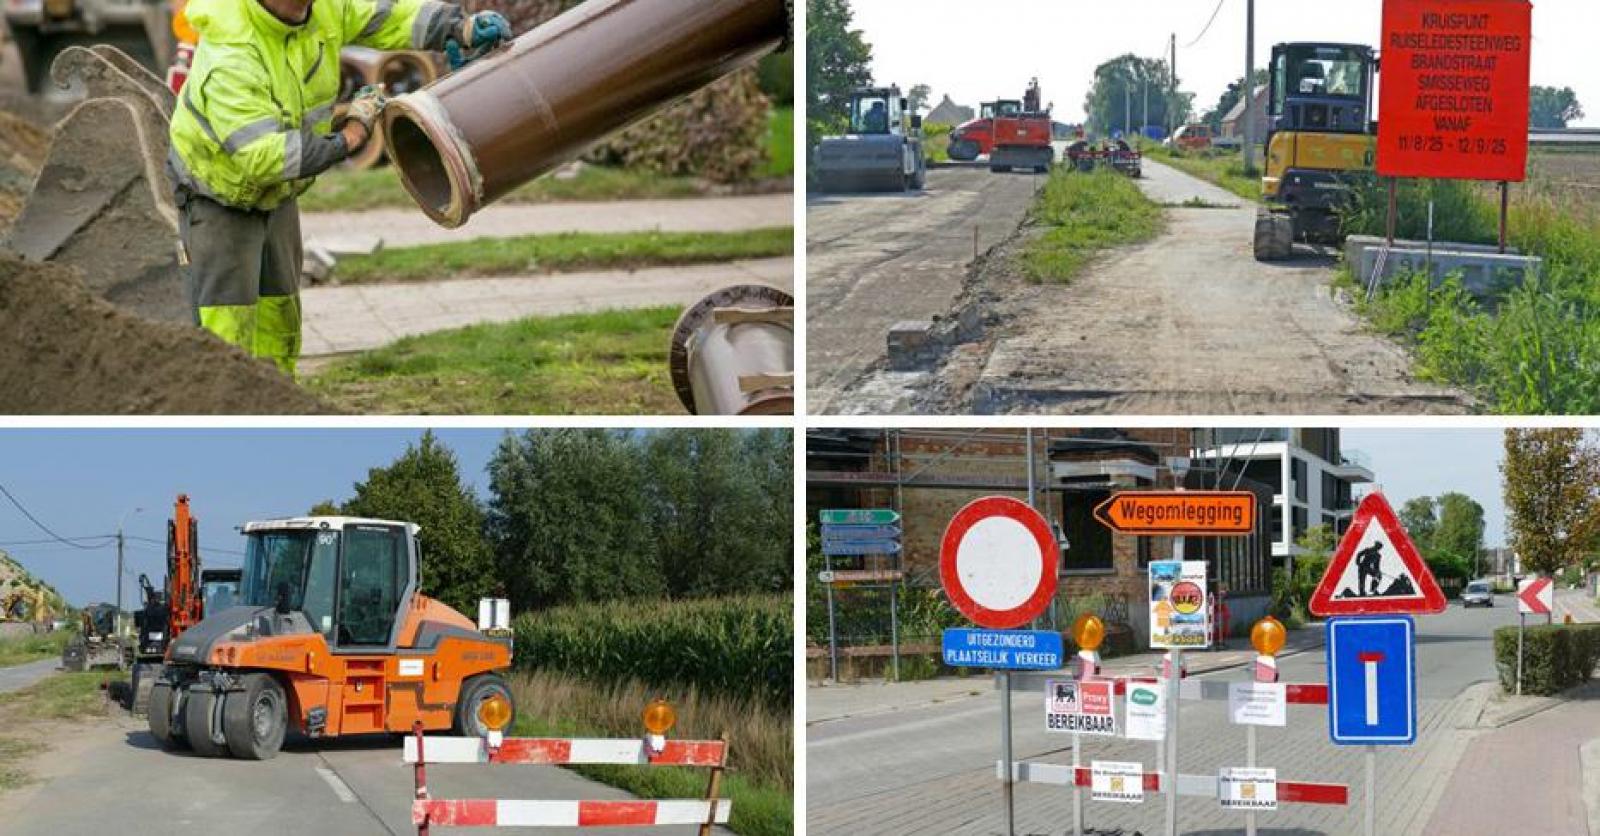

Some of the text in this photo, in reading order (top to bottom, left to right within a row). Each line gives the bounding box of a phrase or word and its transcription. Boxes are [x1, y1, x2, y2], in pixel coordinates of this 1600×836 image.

[1421, 13, 1489, 29] KRUISPUNT
[1390, 33, 1522, 52] RUISELEDESTEENWEG
[1411, 54, 1497, 71] BRANDSTRAAT
[1417, 74, 1490, 92] SMISSEWEG
[1416, 95, 1493, 113] AFGESLOTEN
[1433, 116, 1473, 132] VANAF
[1398, 136, 1444, 152] 11/8/25
[1459, 138, 1507, 154] 12/9/25
[1120, 500, 1243, 525] Wegomlegging
[967, 632, 1035, 648] UITGEZONDERD
[946, 649, 1057, 666] PLAATSELIJK VERKEER
[1047, 713, 1114, 733] BEREIKBAAR
